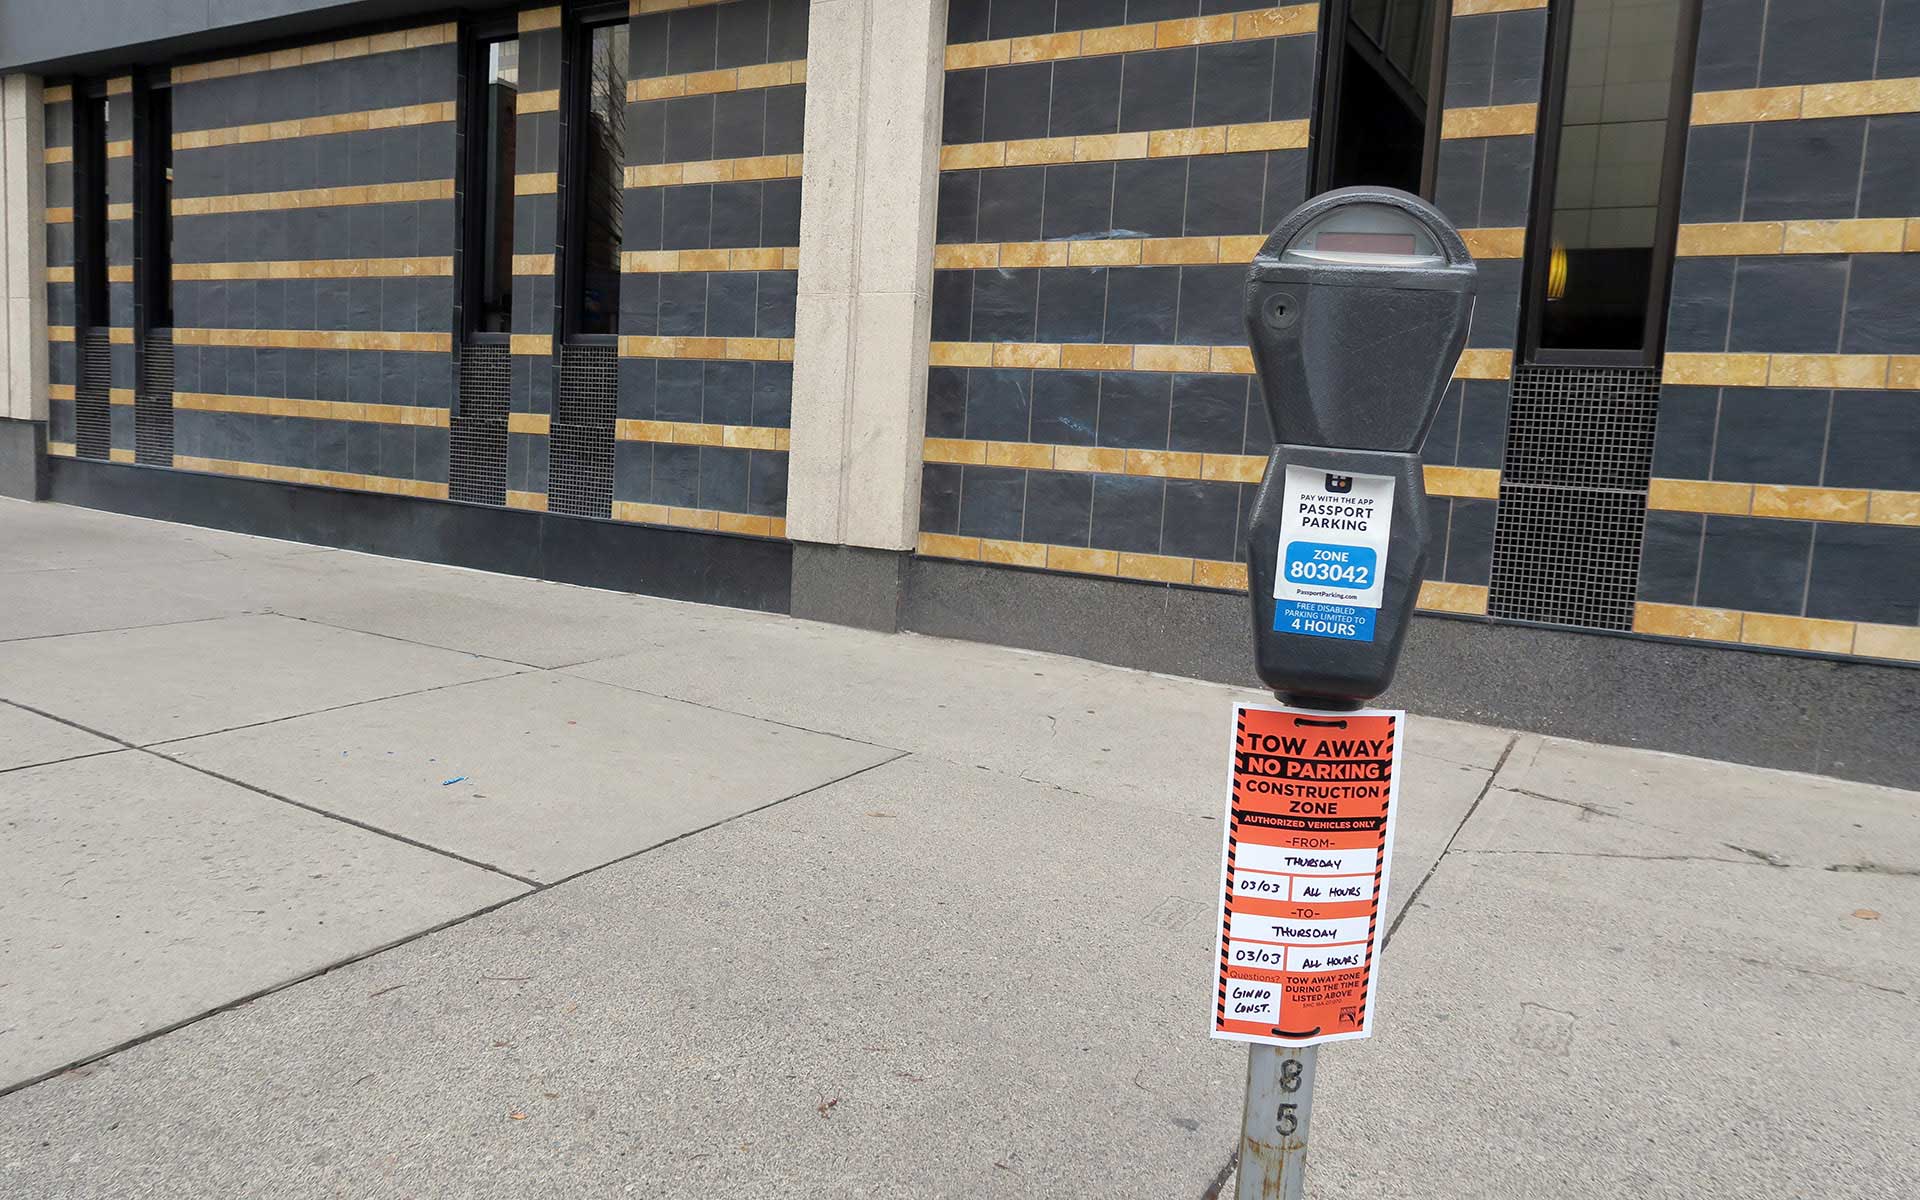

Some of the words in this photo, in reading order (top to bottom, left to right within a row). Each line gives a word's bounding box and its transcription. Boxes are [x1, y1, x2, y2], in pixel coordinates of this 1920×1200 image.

[1300, 494, 1316, 502] PAY
[1317, 495, 1339, 504] WITH
[1340, 497, 1356, 505] THE
[1299, 503, 1374, 519] PASSPORT
[1302, 517, 1368, 532] PARKING
[1312, 549, 1349, 563] ZONE
[1290, 561, 1369, 584] 803042
[1296, 588, 1358, 600] PassportParking.com
[1296, 601, 1316, 611] FREE
[1317, 604, 1355, 616] DISABLED
[1284, 609, 1319, 620] PARKING
[1320, 613, 1353, 624] LIMITED
[1353, 616, 1366, 625] TO
[1291, 619, 1301, 630] 4
[1304, 620, 1356, 636] HOURS
[1247, 733, 1307, 756] TOW
[1313, 739, 1385, 758] AWAY
[1248, 757, 1281, 775] NO
[1287, 760, 1380, 780] PARKING
[1246, 780, 1380, 799] CONSTRUCTION
[1289, 800, 1338, 815] ZONE
[1244, 815, 1306, 829] AUTHORIZED
[1307, 820, 1351, 829] VEHICLES
[1352, 820, 1376, 829] ONLY
[1284, 857, 1342, 870] THURSDAY
[1241, 880, 1280, 893] 03/03
[1303, 886, 1321, 897] ALL
[1329, 886, 1361, 897] HOURS
[1272, 926, 1337, 939] THURSDAY
[1235, 948, 1281, 965] 03/03
[1302, 958, 1321, 970] ALL
[1326, 954, 1359, 966] HOURS
[1229, 970, 1280, 984] Questions?
[1286, 976, 1309, 984] TOW
[1311, 975, 1336, 984] AWAY
[1338, 972, 1360, 981] ZONE
[1285, 985, 1321, 993] DURING
[1322, 983, 1339, 991] THE
[1340, 980, 1360, 989] TIME
[1292, 994, 1323, 1002] LISTED
[1324, 989, 1352, 1001] ABOVE
